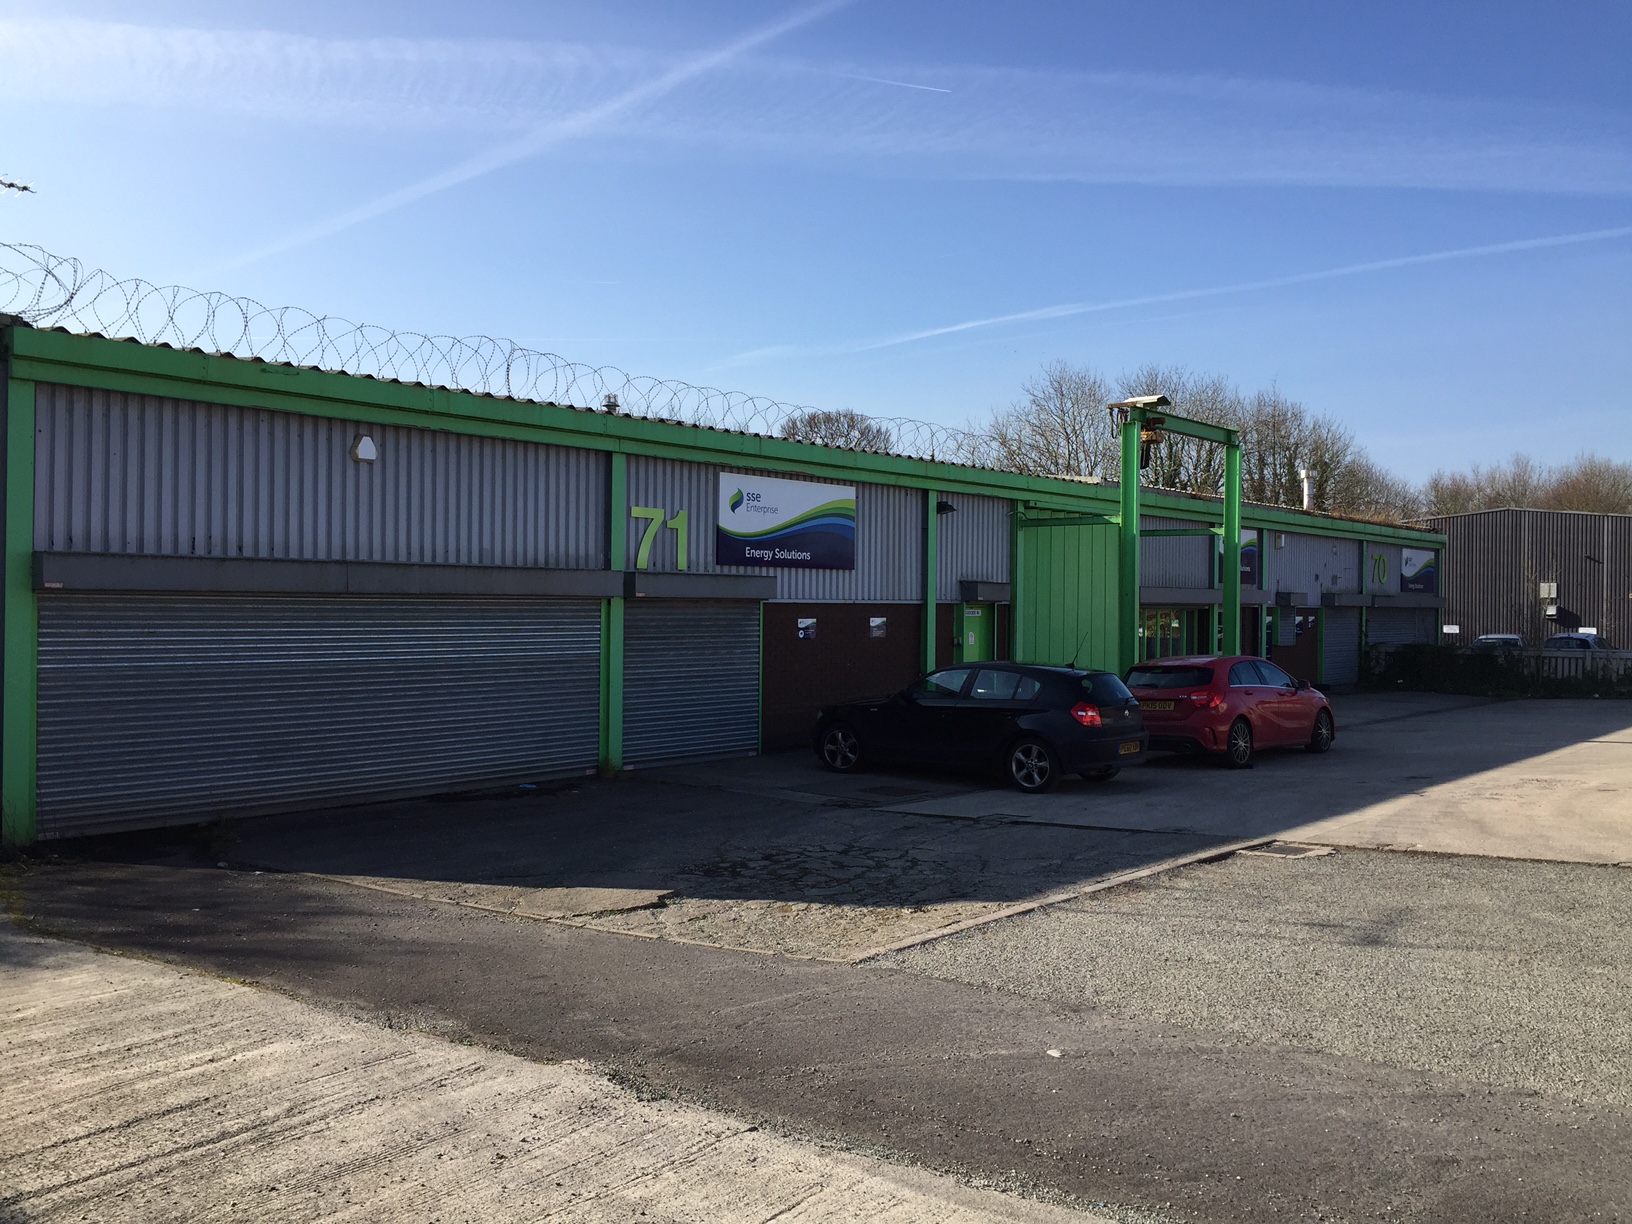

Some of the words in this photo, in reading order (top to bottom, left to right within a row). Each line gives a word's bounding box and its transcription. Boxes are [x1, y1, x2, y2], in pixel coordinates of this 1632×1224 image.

[746, 492, 762, 503] sse
[746, 503, 779, 515] Enterprise
[631, 506, 688, 571] 71
[745, 547, 774, 561] Energy
[774, 548, 811, 561] Solutions
[1371, 553, 1388, 584] 70
